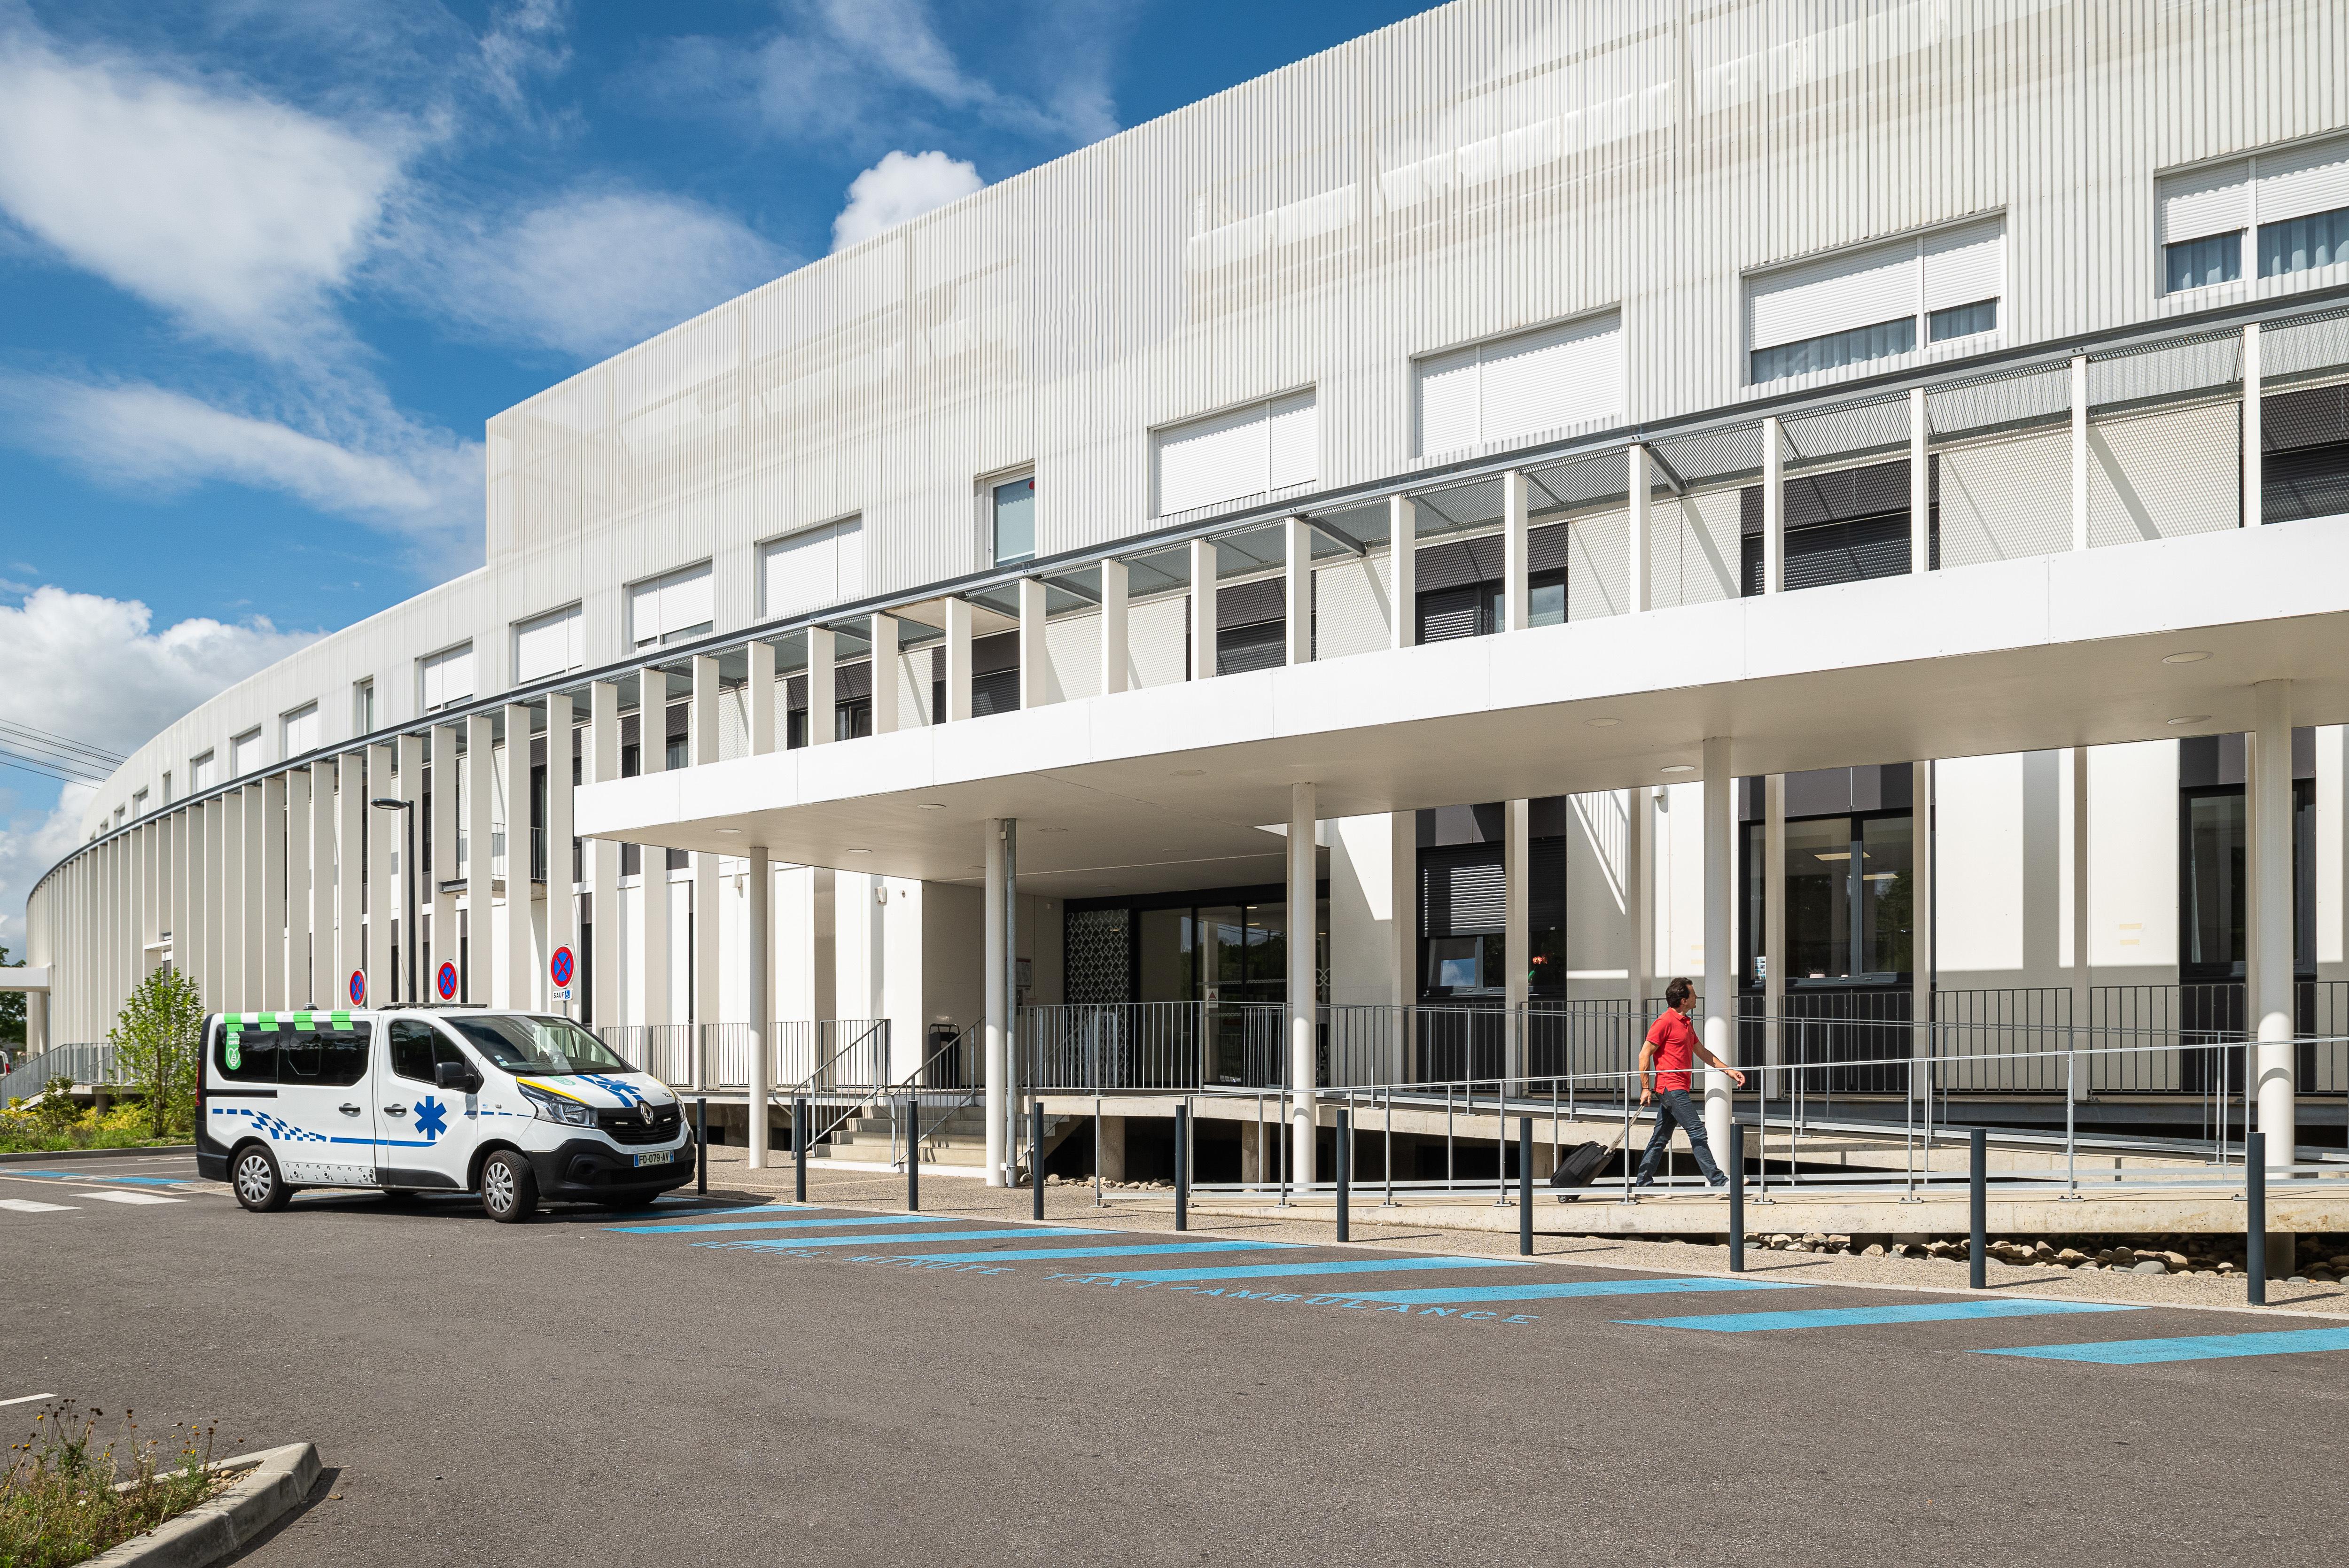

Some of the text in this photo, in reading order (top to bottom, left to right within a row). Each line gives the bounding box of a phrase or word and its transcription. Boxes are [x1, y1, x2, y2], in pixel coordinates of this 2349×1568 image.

[639, 1152, 669, 1164] FD-079-AV
[688, 1242, 833, 1258] DEPOSE
[842, 1256, 1015, 1275] MINUTE
